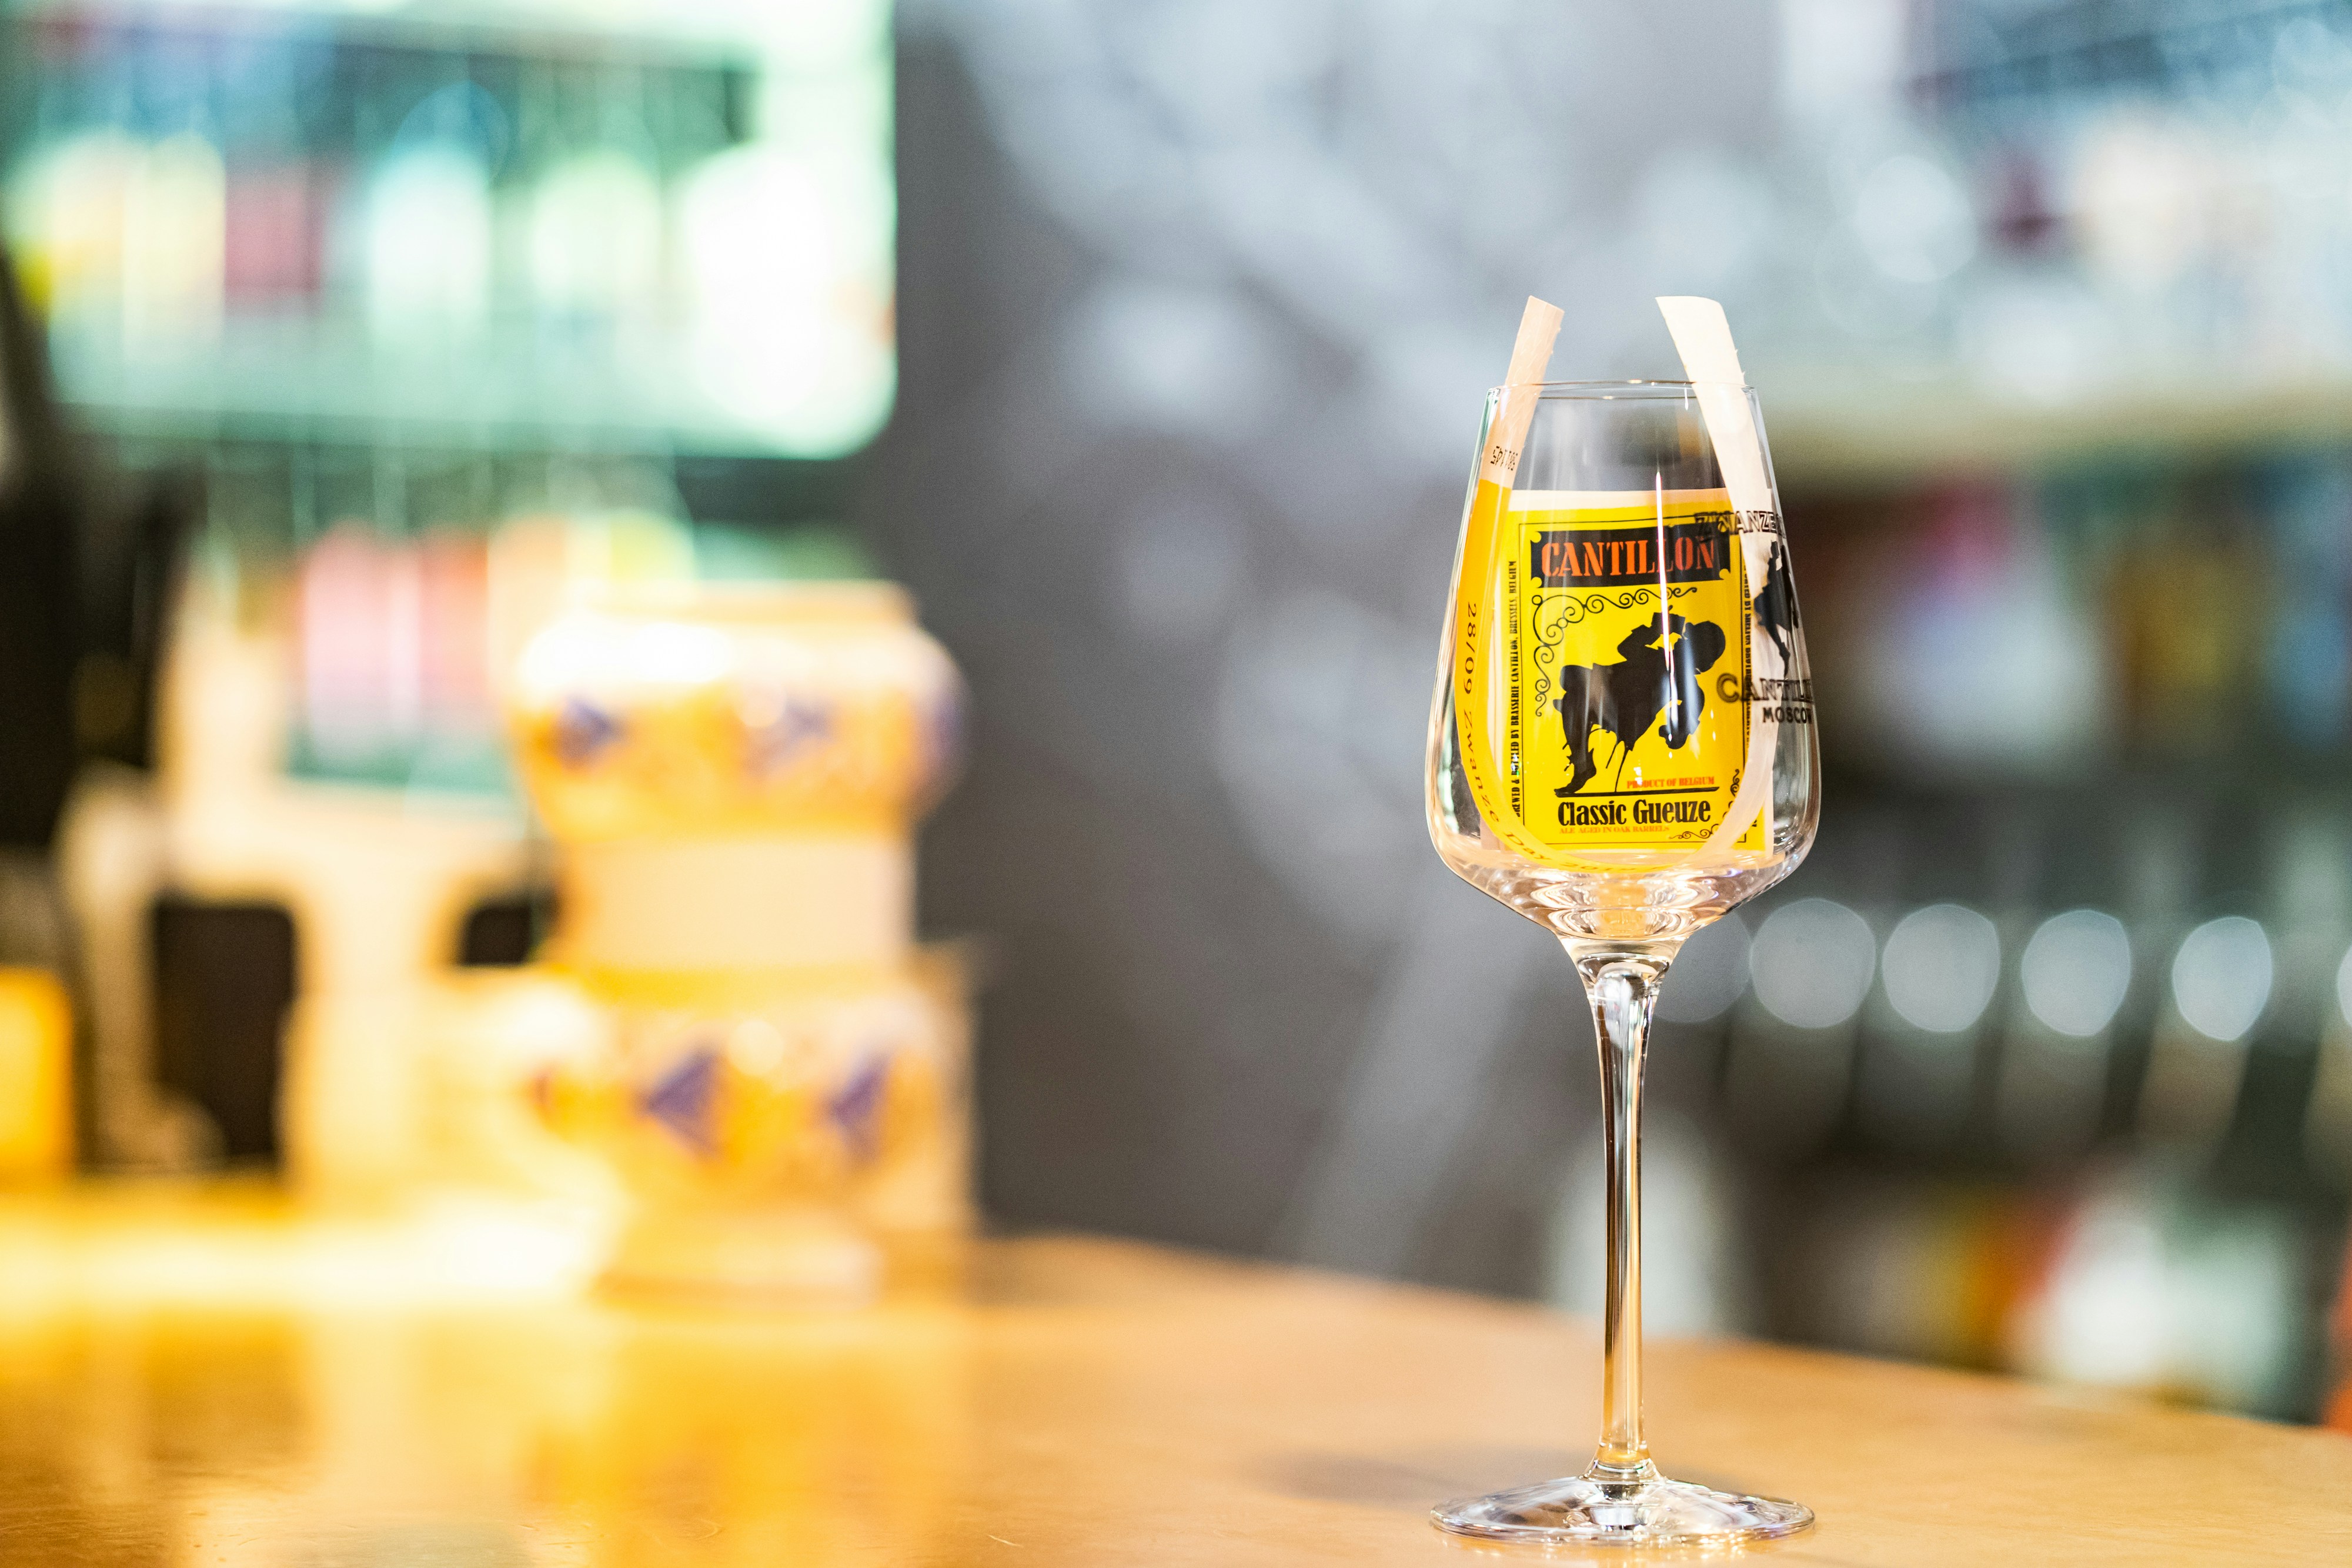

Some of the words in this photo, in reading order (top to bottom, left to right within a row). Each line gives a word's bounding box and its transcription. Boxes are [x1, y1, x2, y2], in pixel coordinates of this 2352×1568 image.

[1541, 536, 1715, 577] CANTILLON
[1508, 561, 1516, 594] BELGIUM
[1464, 601, 1477, 695] 28/09
[1511, 686, 1519, 726] BRASSERIE
[1511, 729, 1519, 739] BY
[1464, 708, 1499, 823] Zwanze
[1627, 779, 1665, 788] PRODUCT
[1666, 778, 1676, 787] OF
[1679, 776, 1715, 786] BELGIUM
[1558, 800, 1627, 826] Classic
[1633, 799, 1710, 824] Gueuze
[1503, 831, 1552, 860] Day
